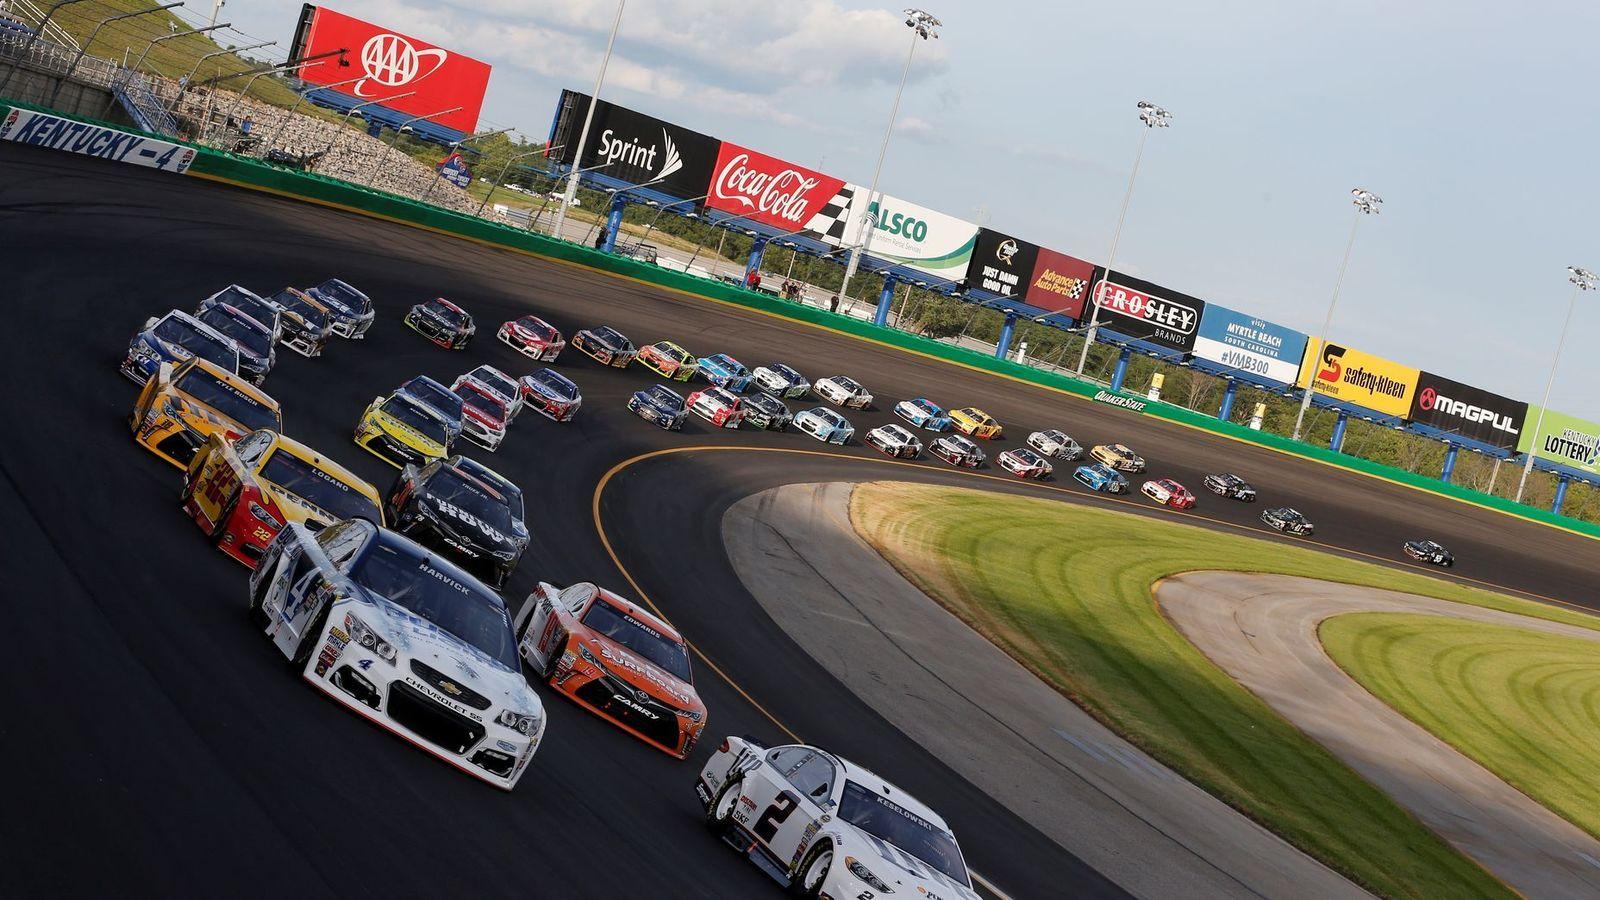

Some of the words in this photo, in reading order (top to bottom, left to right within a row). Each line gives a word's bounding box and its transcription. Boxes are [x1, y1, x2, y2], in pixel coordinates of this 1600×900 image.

[364, 36, 416, 84] AAA
[598, 129, 657, 171] Sprint
[715, 153, 820, 223] Coca-Cola
[982, 265, 999, 279] JUST
[999, 271, 1019, 286] DAMN
[982, 278, 1001, 292] GOOD
[1001, 285, 1011, 296] OIL
[1034, 277, 1051, 291] Auto
[1051, 284, 1070, 296] Parts
[1040, 268, 1074, 288] Advance
[1099, 286, 1194, 330] CROSLEY
[1153, 329, 1187, 345] BRANDS
[1224, 336, 1245, 347] SOUTH
[1247, 343, 1278, 357] CAROLINA
[1227, 323, 1257, 340] MYRTLE
[1257, 331, 1282, 348] BEACH
[1221, 350, 1269, 374] #VMB300
[216, 380, 234, 392] KYLE
[235, 390, 258, 406] BUSCH
[1433, 395, 1519, 435] MAGPUL
[1545, 435, 1591, 462] LOTTERY
[1563, 429, 1597, 446] KENTUCKY
[311, 468, 349, 492] LOGANO
[253, 526, 271, 541] 22
[444, 538, 479, 558] CAMRY
[419, 563, 470, 595] HARVICK
[623, 615, 661, 639] EDWARDS
[358, 659, 374, 671] 4
[405, 676, 467, 714] CHEVROLET
[469, 712, 483, 723] SS
[613, 694, 660, 720] CAMRY
[734, 810, 749, 825] SKF
[752, 790, 801, 845] 2
[876, 796, 933, 831] KESELOWSKI
